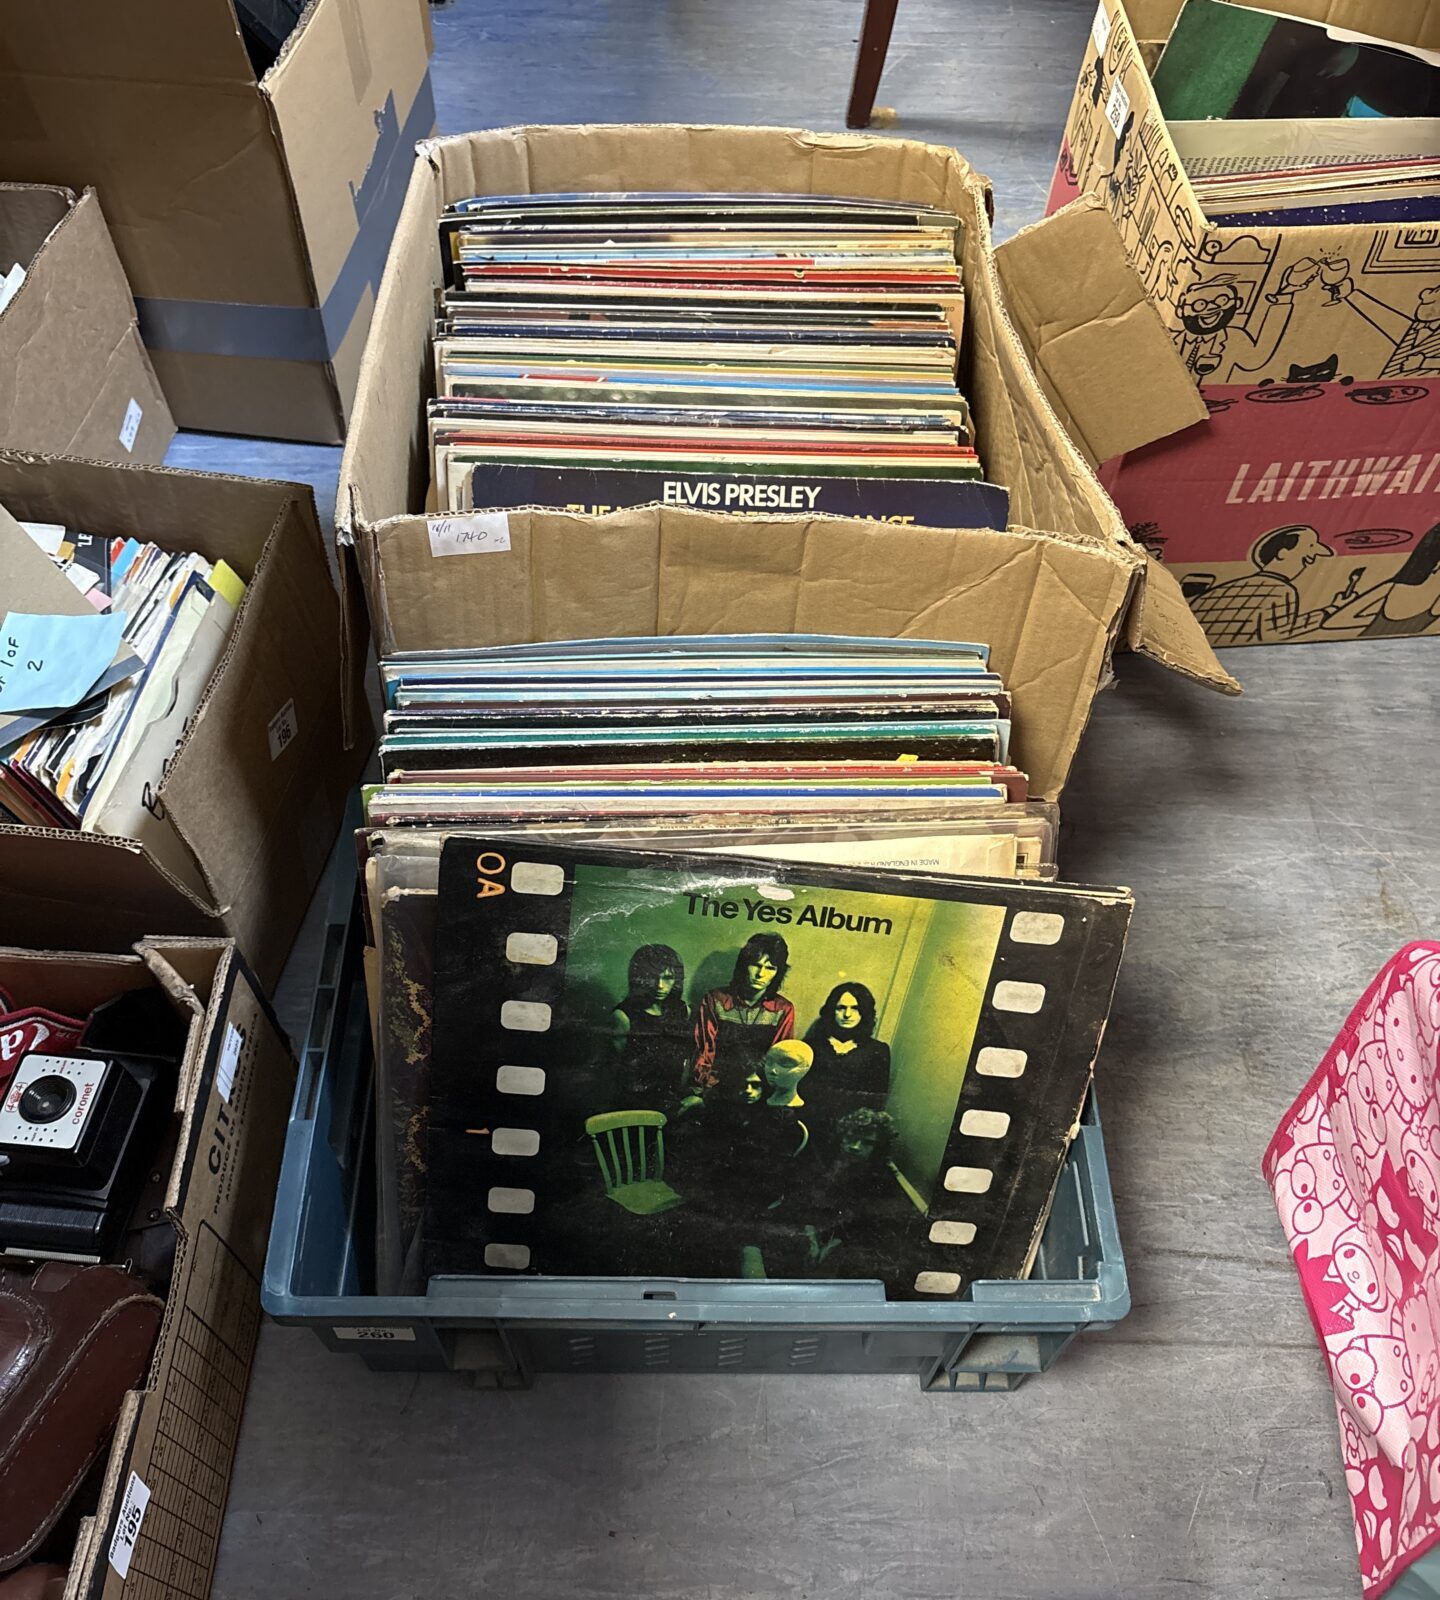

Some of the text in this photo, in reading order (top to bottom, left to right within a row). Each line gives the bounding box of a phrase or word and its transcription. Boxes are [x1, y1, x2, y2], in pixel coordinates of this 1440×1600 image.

[663, 481, 822, 509] ELVIS PRESLEY
[1225, 453, 1440, 504] LAITHWAI
[27, 659, 44, 672] 2
[919, 858, 940, 866] MADE
[682, 891, 893, 936] The Yes Album
[72, 1082, 95, 1125] coronet
[214, 1142, 231, 1215] PRODUCE
[357, 1331, 395, 1339] 260
[109, 1475, 137, 1560] Badgers Auctions
[119, 1525, 128, 1541] Lot
[123, 1504, 142, 1547] 195
